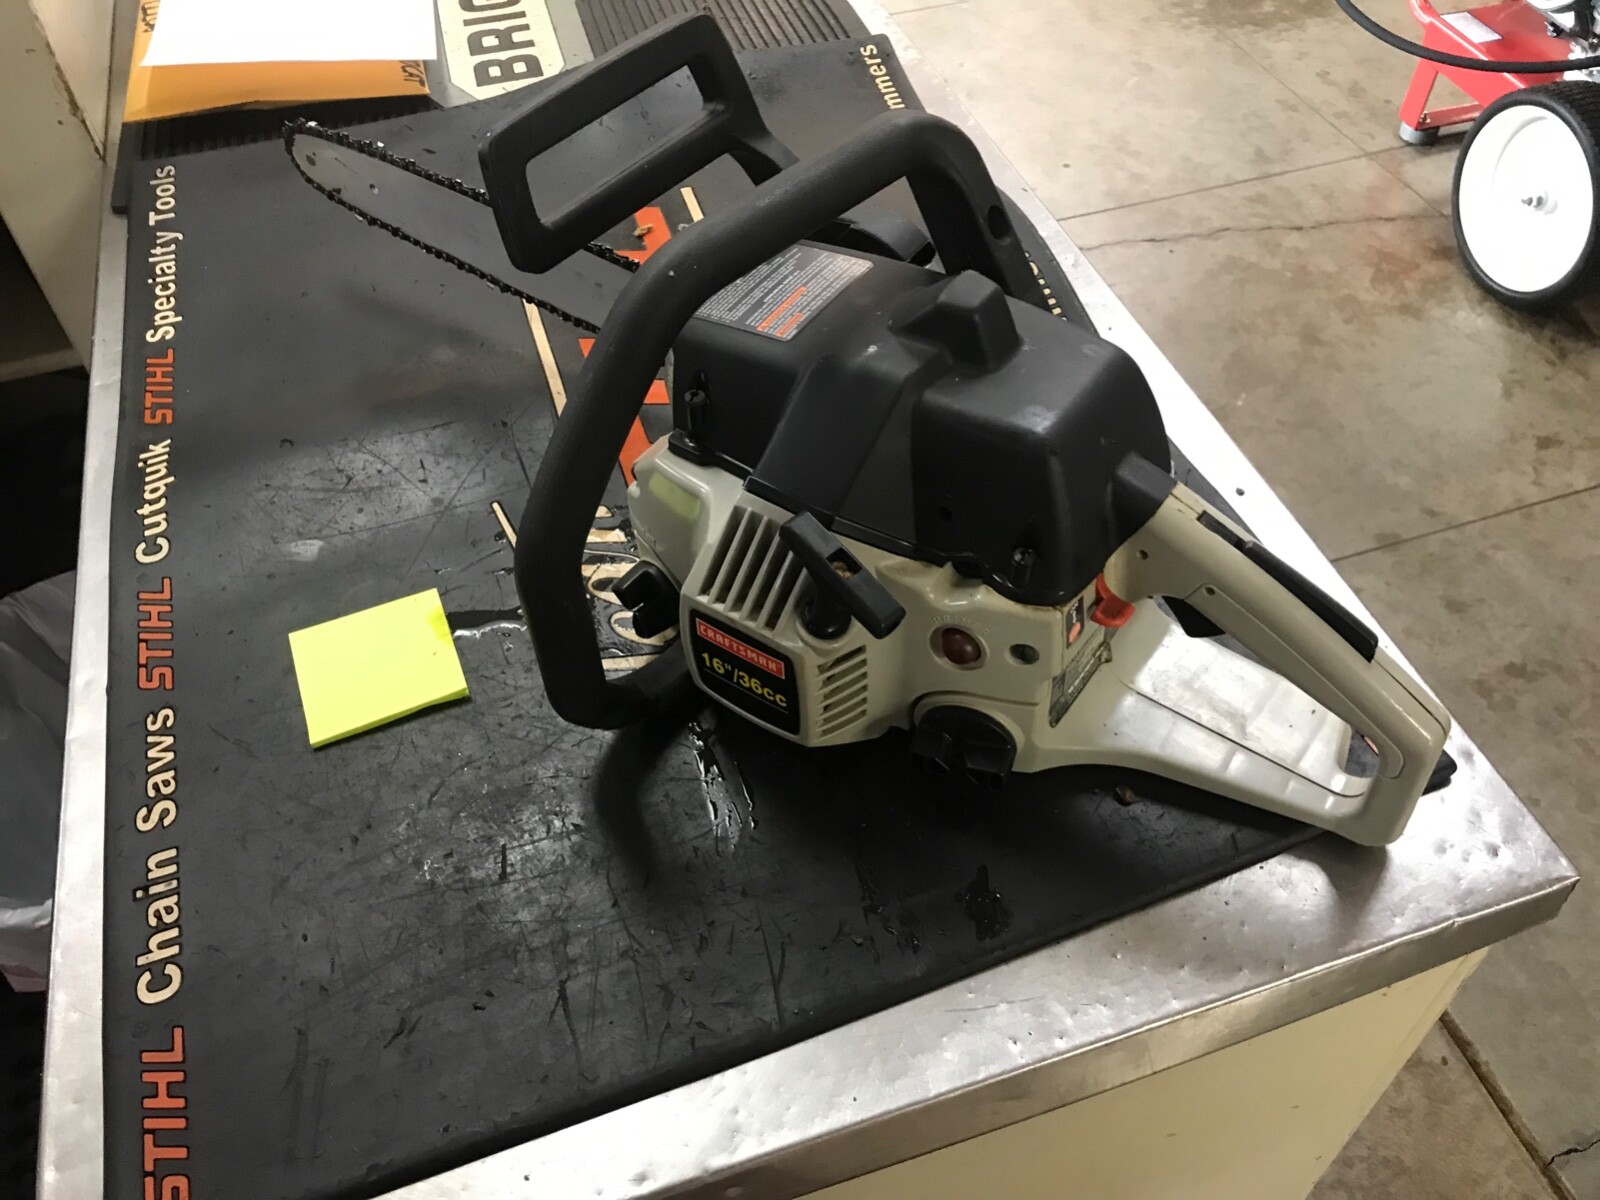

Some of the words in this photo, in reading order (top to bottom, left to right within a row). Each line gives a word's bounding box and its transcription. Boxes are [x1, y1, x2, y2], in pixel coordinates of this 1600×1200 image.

[148, 164, 176, 227] Tools
[145, 231, 184, 343] Specialty
[144, 347, 175, 425] STIHL
[135, 438, 176, 564] Cutquik
[137, 576, 175, 691] STIHL
[699, 623, 778, 673] CRAFTSMAN
[135, 707, 178, 832] Saws
[134, 847, 182, 1005] Chain
[140, 1026, 190, 1200] STIHL
